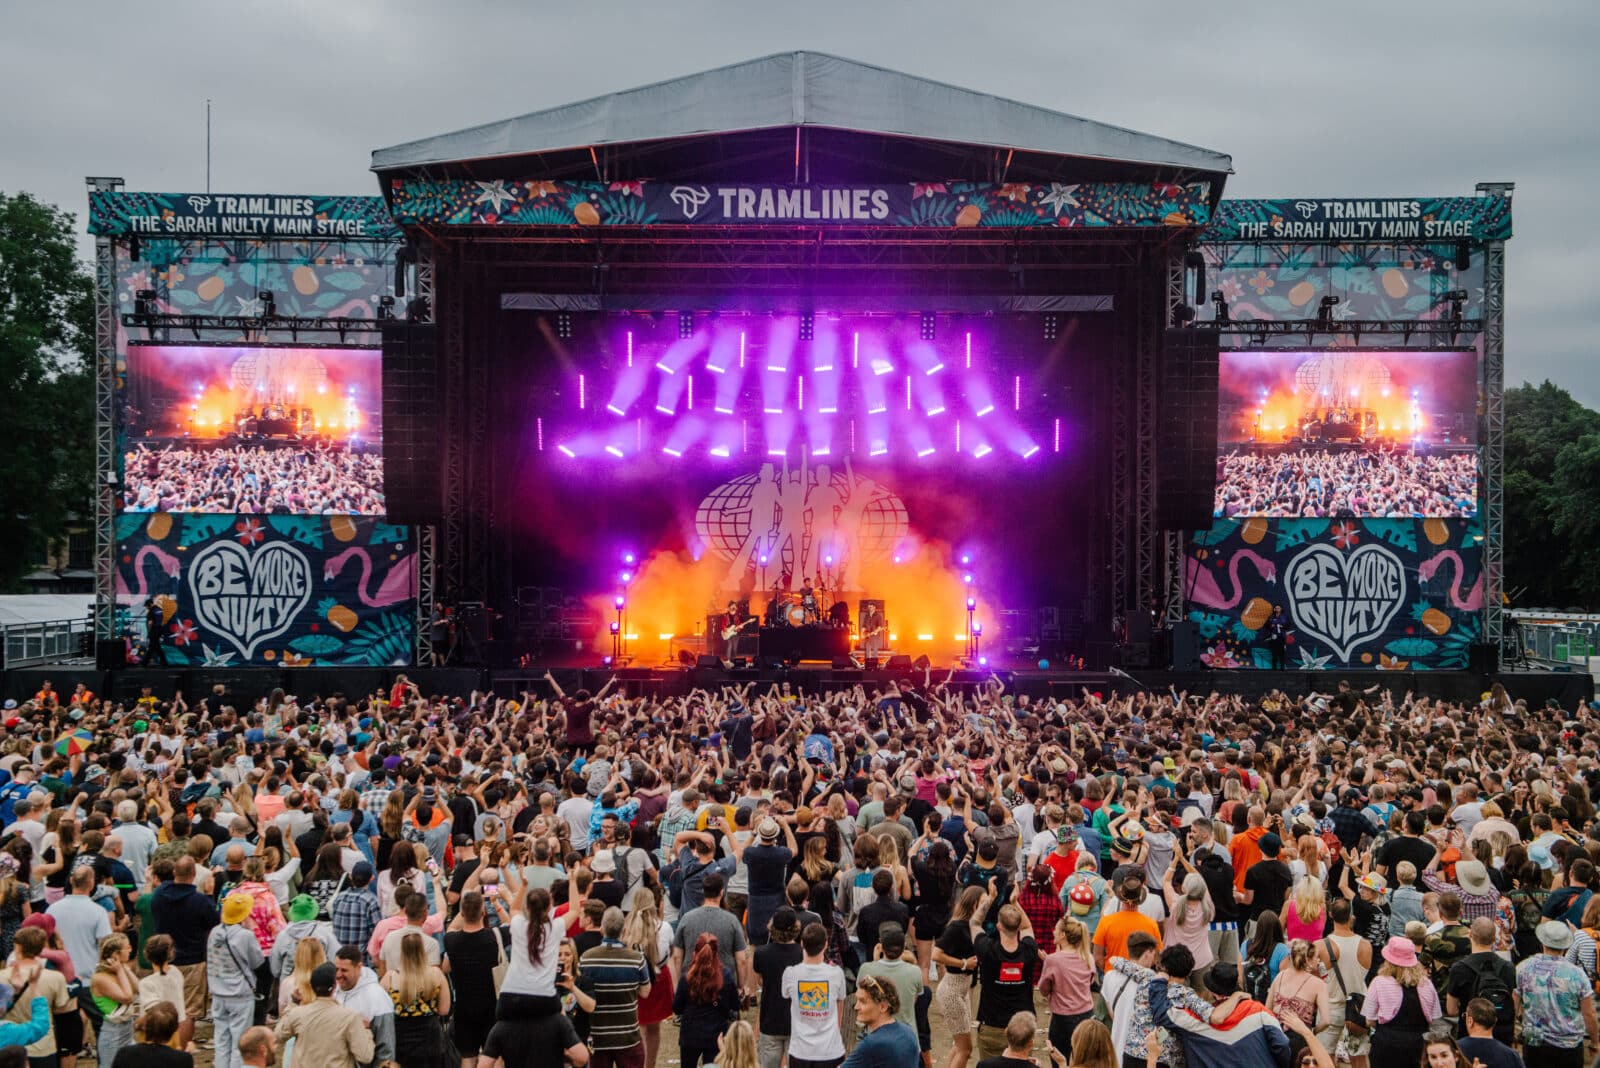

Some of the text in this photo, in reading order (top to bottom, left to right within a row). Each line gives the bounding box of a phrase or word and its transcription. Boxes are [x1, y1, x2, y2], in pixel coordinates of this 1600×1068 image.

[216, 197, 314, 215] TRAMLINES
[718, 188, 890, 219] TRAMLINES
[1322, 201, 1421, 218] TRAMLINES
[130, 216, 366, 236] THE SARAH NULTY MAIN STAGE
[1238, 220, 1473, 238] THE SARAH NULTY MAIN STAGE
[198, 549, 305, 596] BE MORE
[1294, 552, 1400, 599] BE MORE
[201, 597, 299, 643] NULTY
[1297, 600, 1393, 646] NULTY
